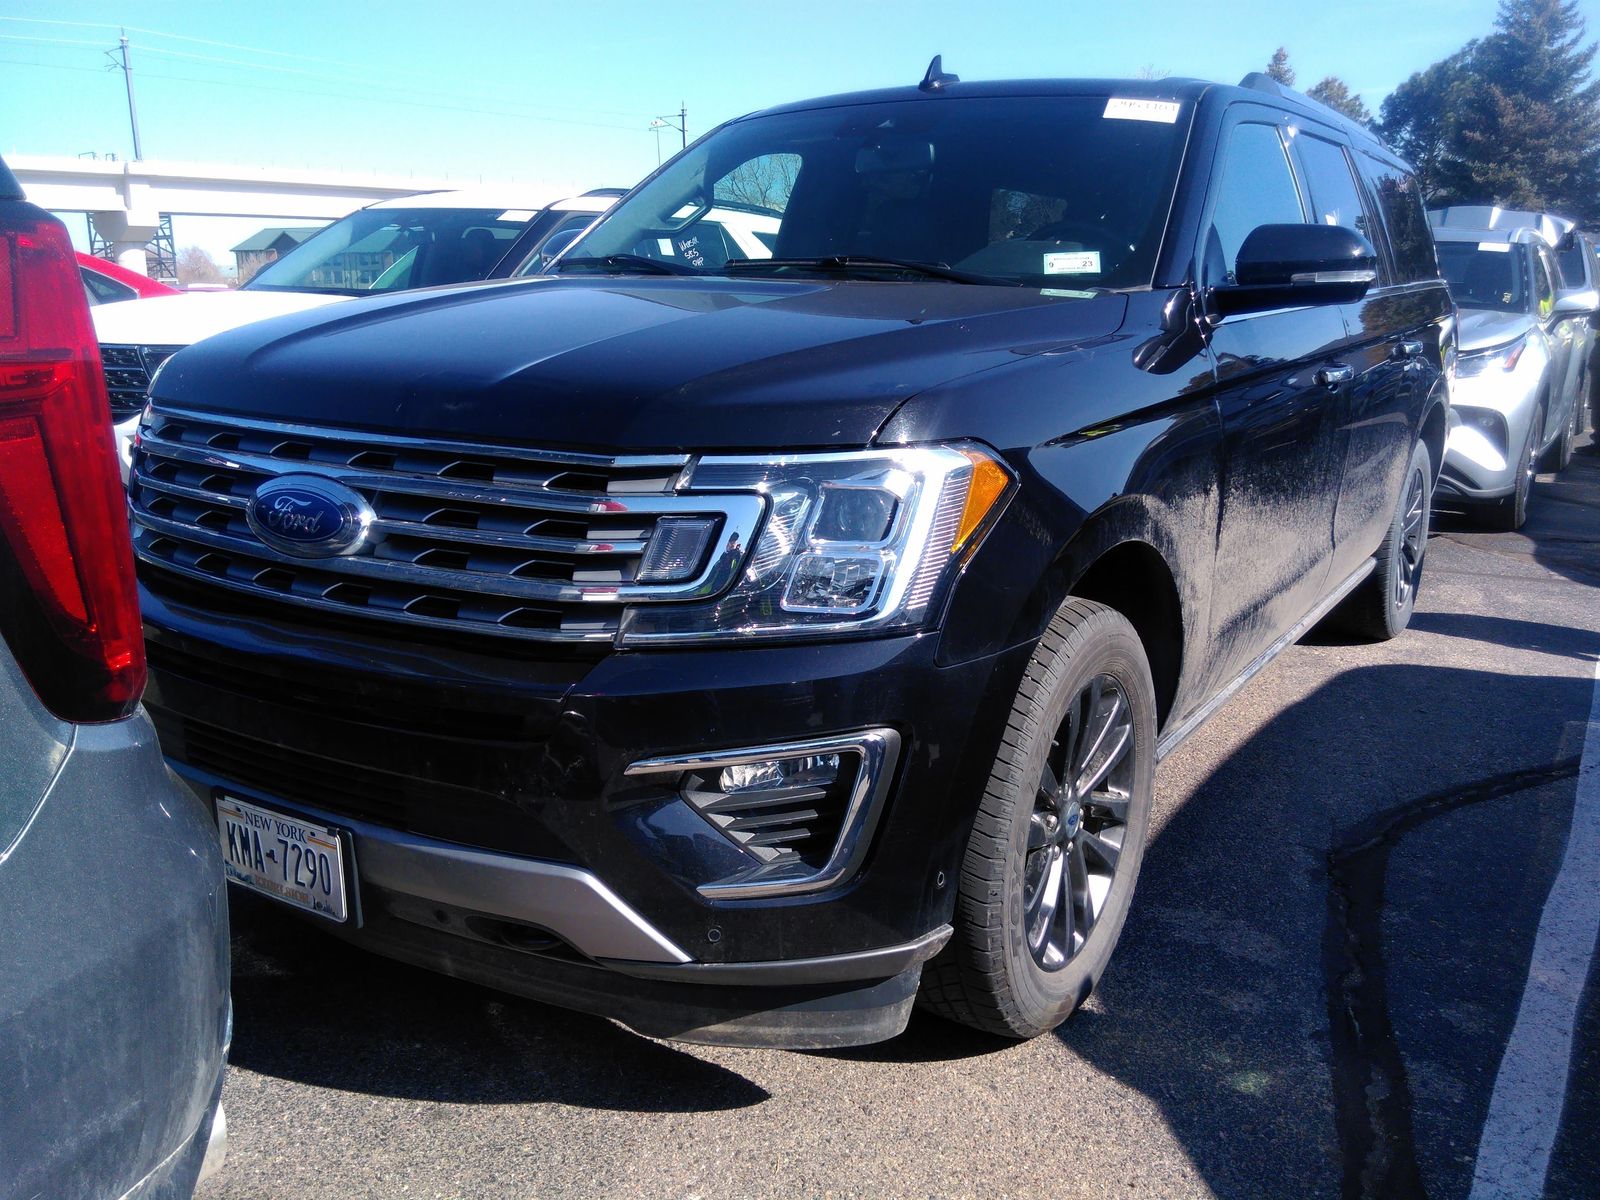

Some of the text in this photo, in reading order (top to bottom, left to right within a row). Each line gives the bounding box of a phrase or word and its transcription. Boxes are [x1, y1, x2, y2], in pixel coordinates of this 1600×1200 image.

[269, 495, 324, 534] Ford
[244, 810, 308, 845] NEW YORK
[226, 820, 332, 896] KMA 7290
